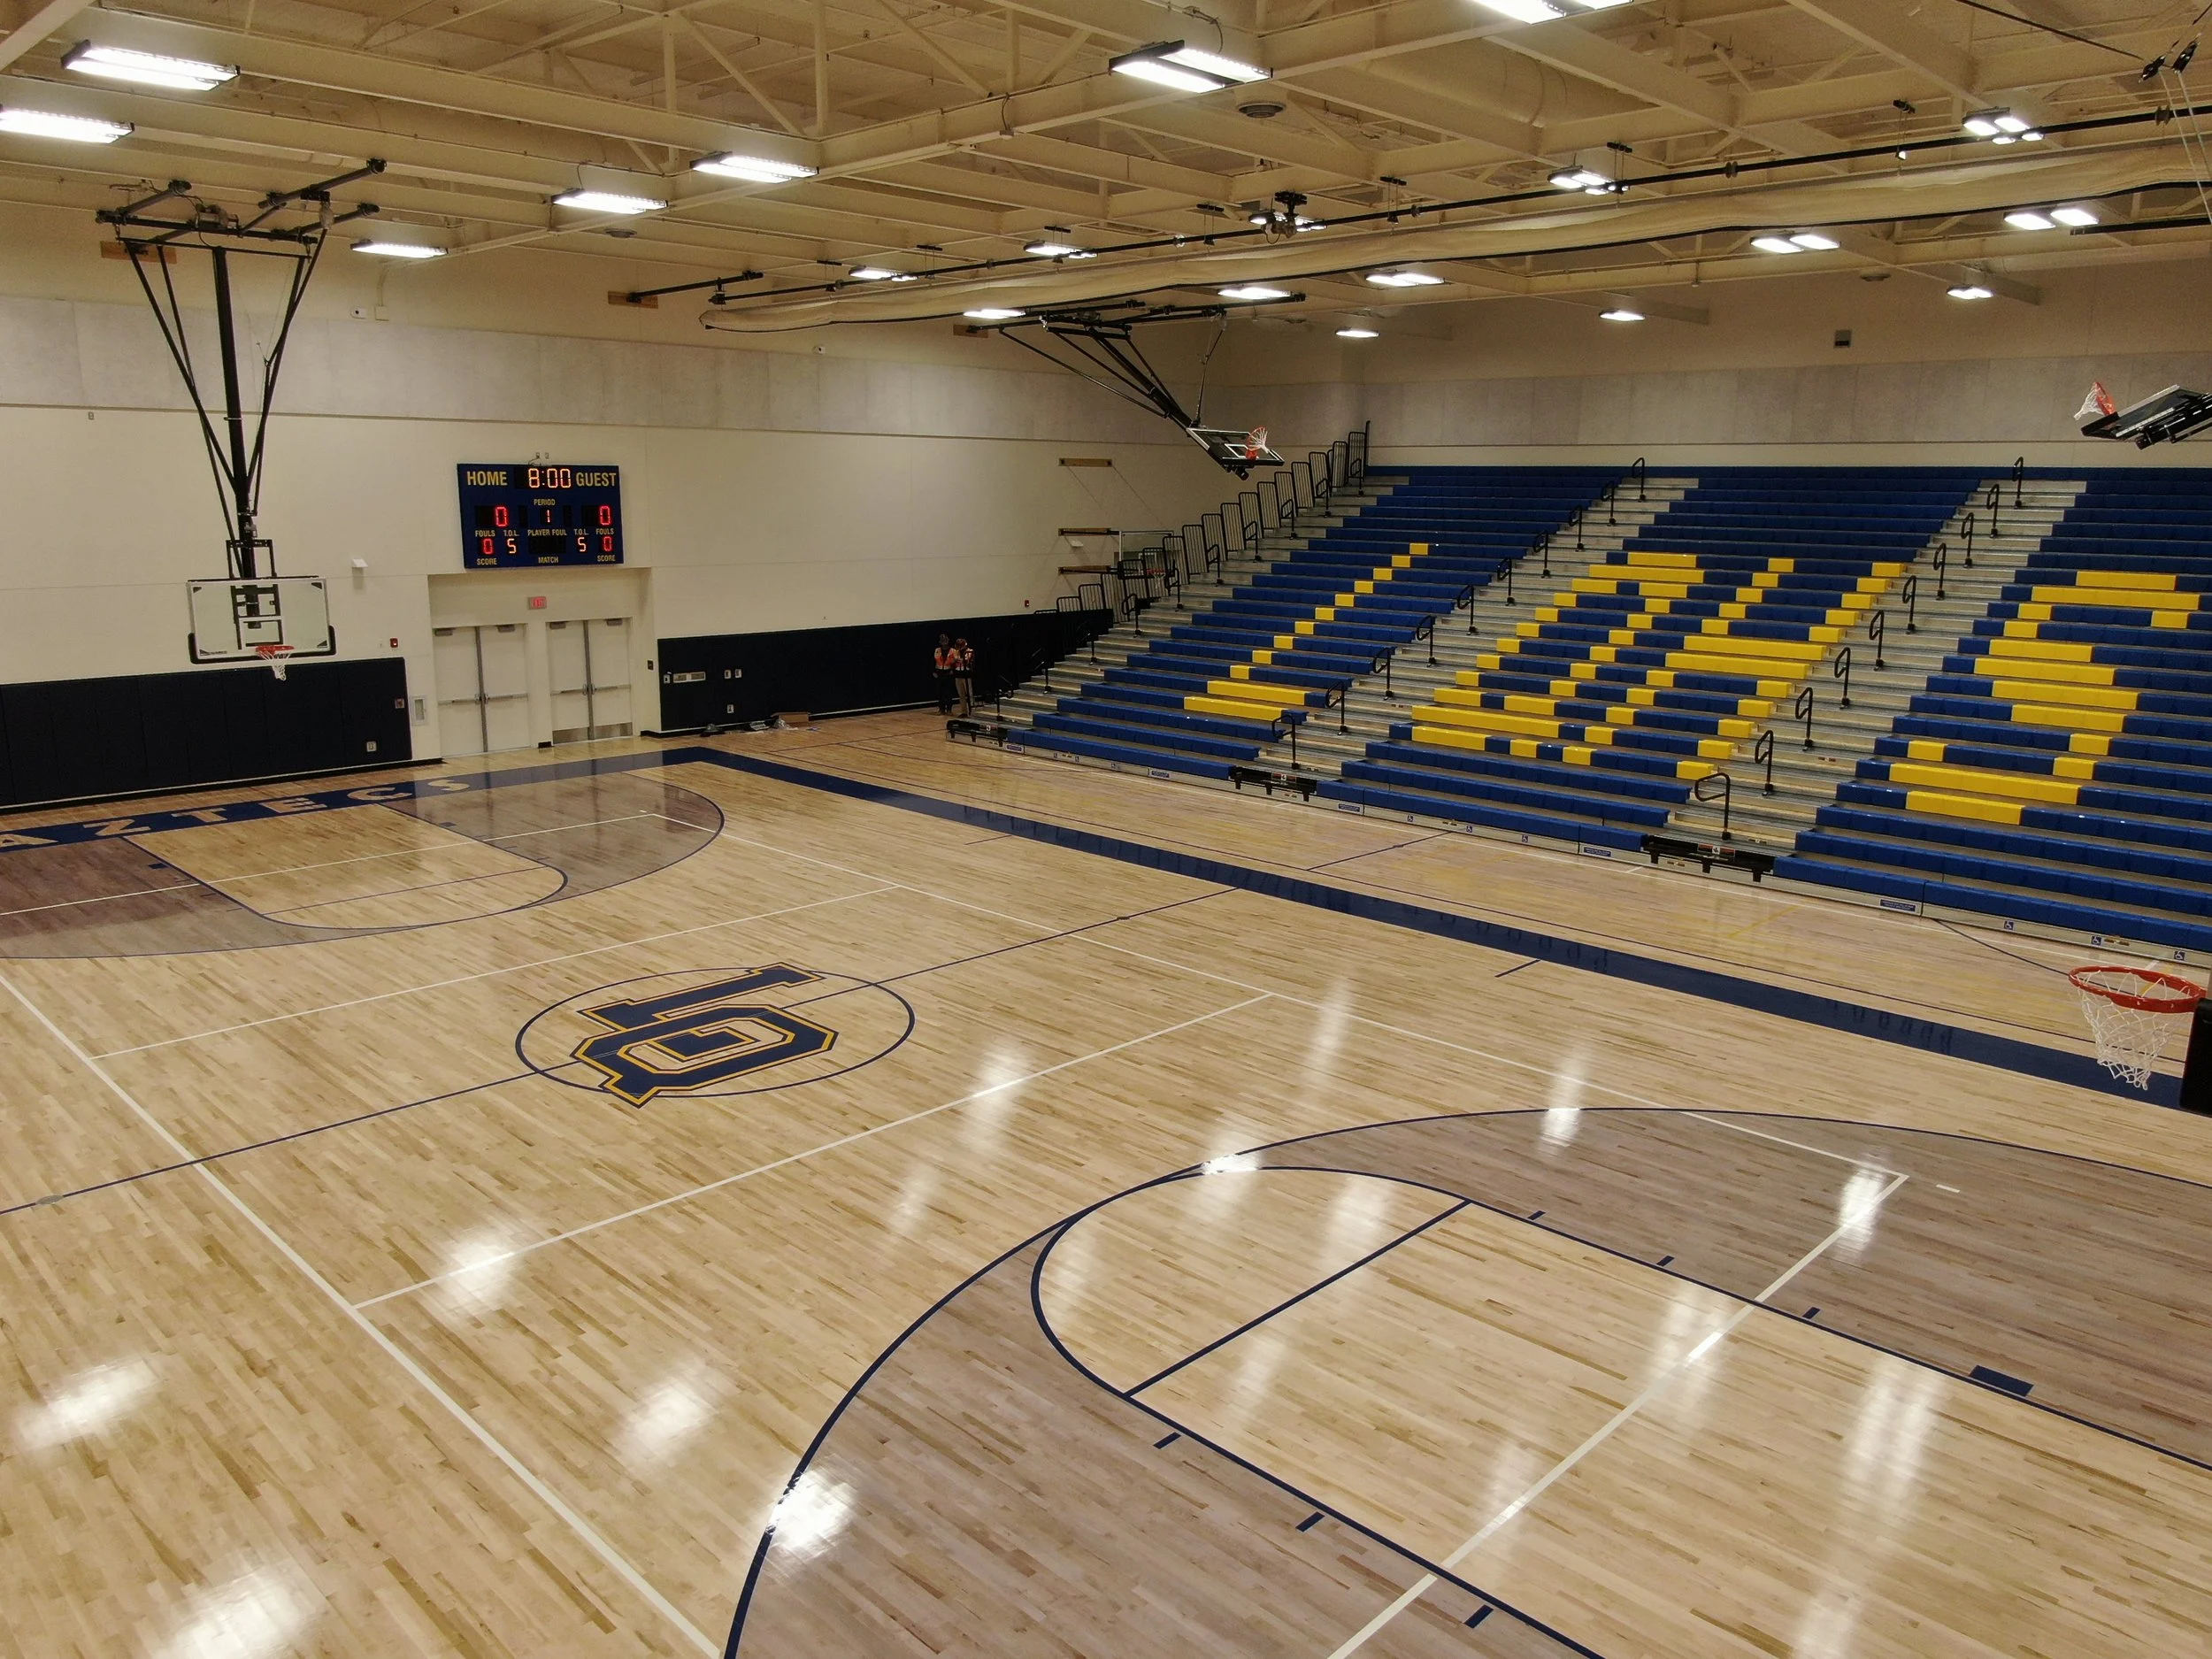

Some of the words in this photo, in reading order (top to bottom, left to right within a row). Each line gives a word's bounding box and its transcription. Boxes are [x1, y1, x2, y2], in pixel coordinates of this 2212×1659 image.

[466, 471, 508, 486] HOME
[528, 468, 572, 488] 8:00
[576, 472, 617, 487] GUEST
[495, 506, 509, 527] 0
[546, 509, 551, 523] 1
[598, 505, 611, 526] 0
[482, 538, 494, 555] 0
[506, 538, 517, 554] 5
[577, 536, 587, 552] 5
[603, 536, 613, 552] 0
